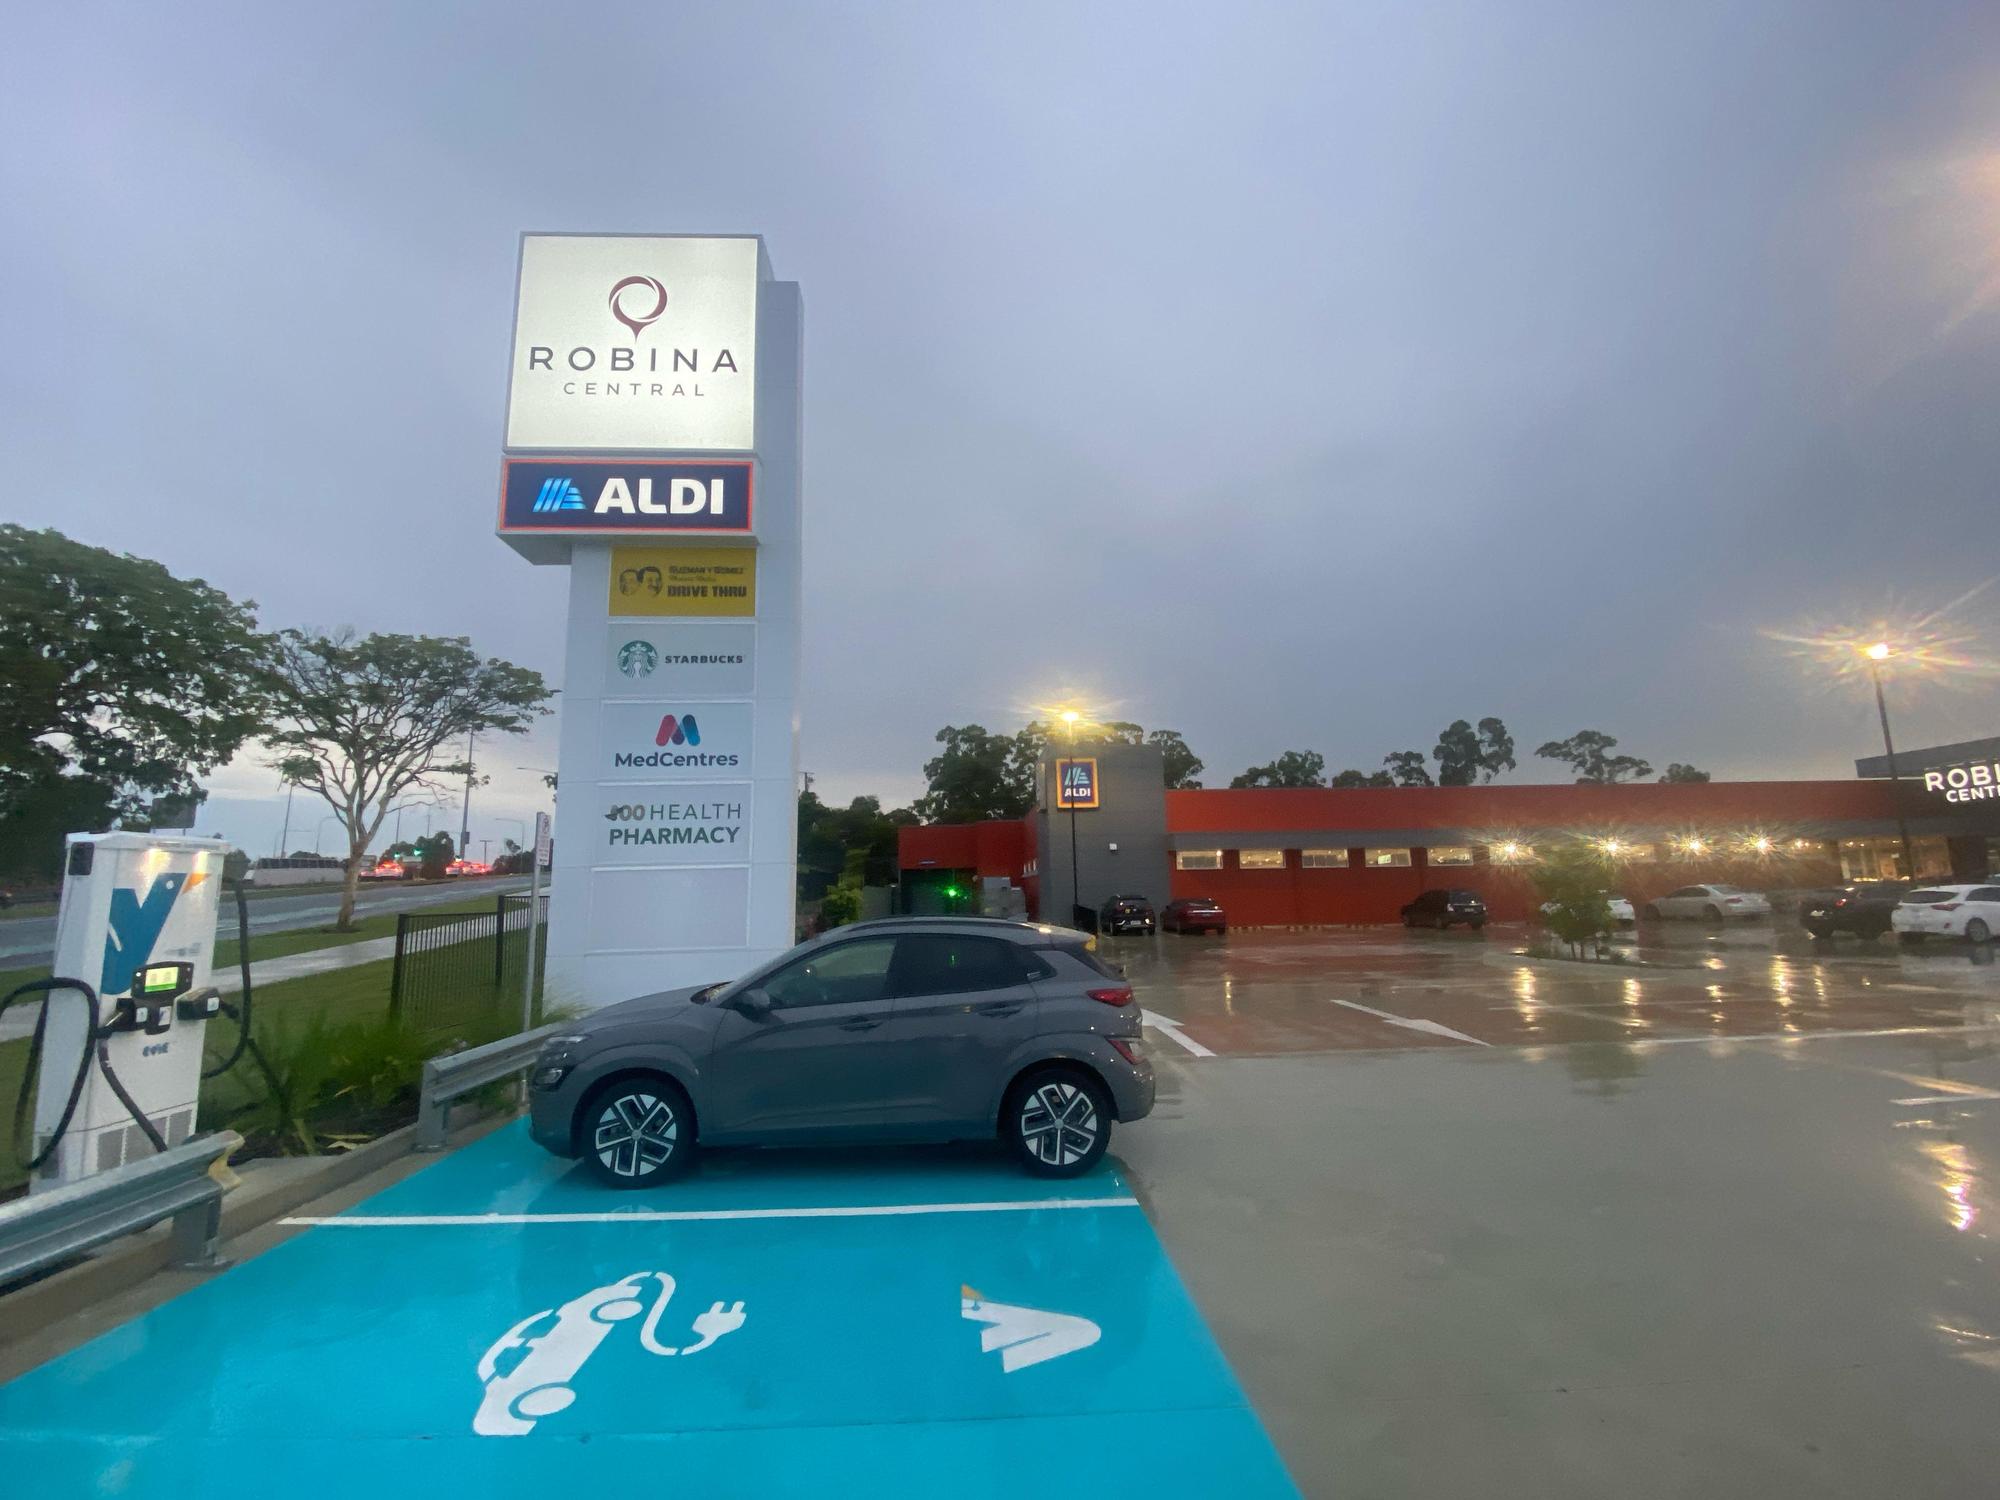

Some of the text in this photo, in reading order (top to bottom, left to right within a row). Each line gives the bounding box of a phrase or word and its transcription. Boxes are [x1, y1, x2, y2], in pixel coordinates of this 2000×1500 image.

[529, 346, 738, 373] ROBINA
[563, 382, 704, 397] CENTRAL
[593, 478, 724, 515] ALDI
[667, 585, 747, 598] DRIVE THRU
[664, 655, 743, 664] STARBUCKS
[614, 752, 738, 768] MedCentres
[1064, 787, 1091, 797] ALDI
[1946, 785, 2000, 802] CENT
[650, 803, 741, 820] HEALTH
[609, 826, 741, 845] PHARMACY
